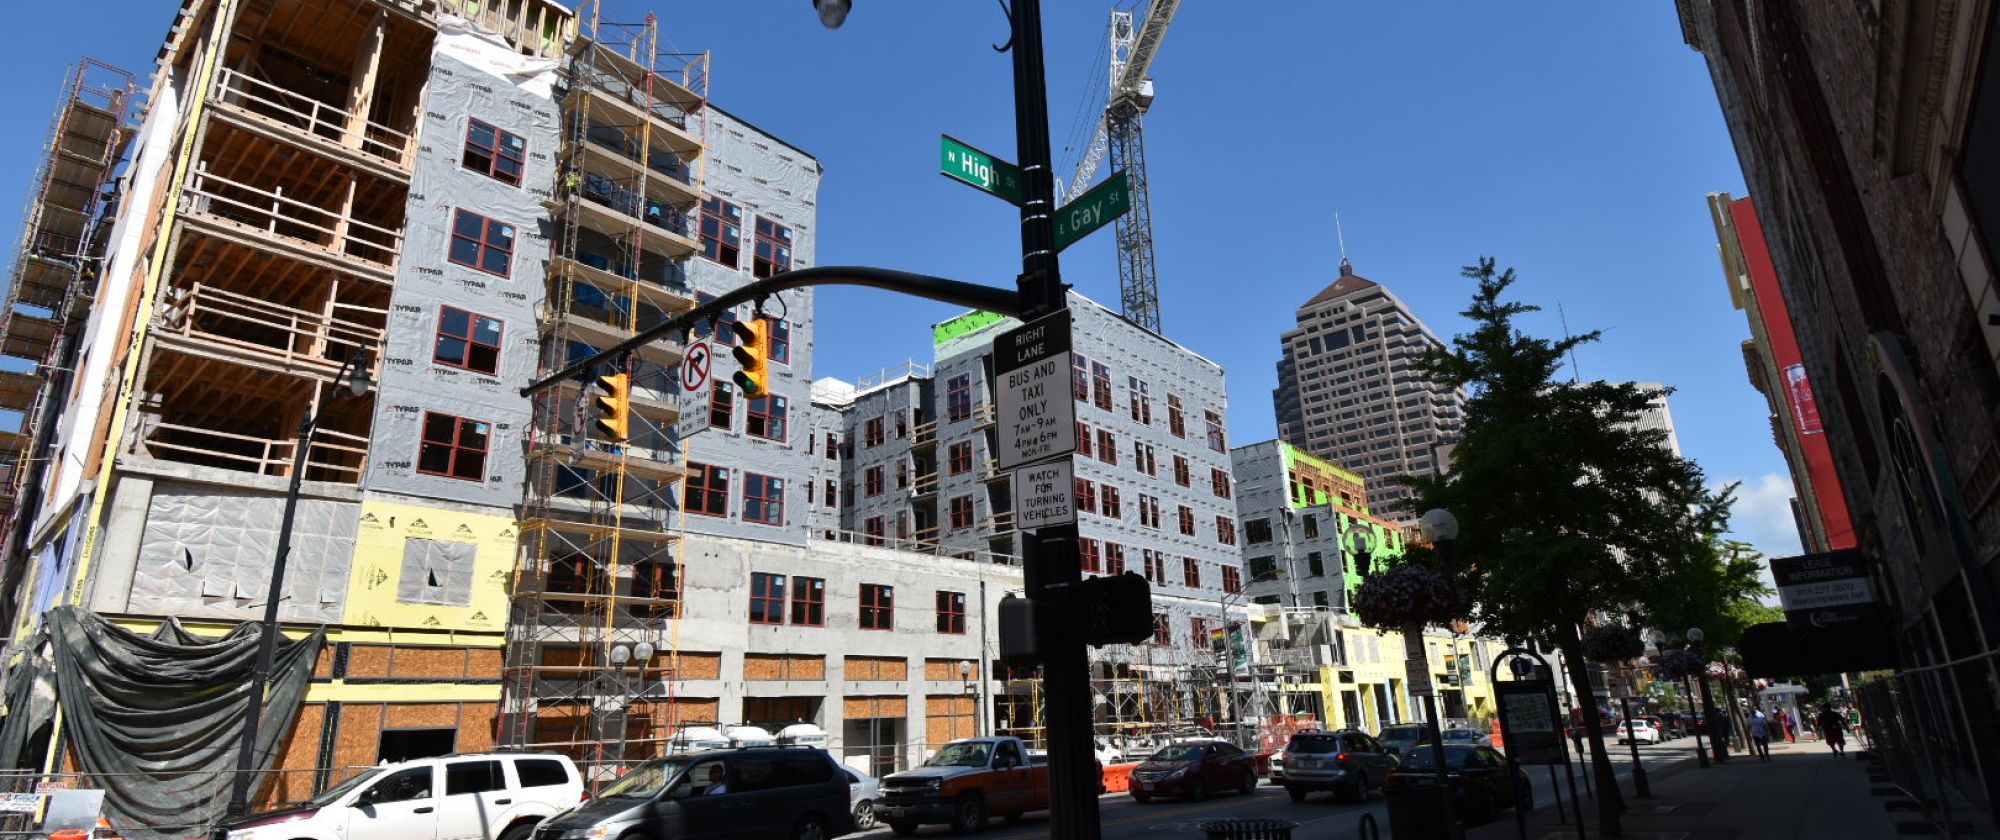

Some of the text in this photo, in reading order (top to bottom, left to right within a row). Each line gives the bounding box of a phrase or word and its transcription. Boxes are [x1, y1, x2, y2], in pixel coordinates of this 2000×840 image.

[948, 150, 955, 163] N
[962, 152, 1000, 187] High
[1059, 191, 1120, 235] E Gay St
[418, 265, 444, 278] TYPAR
[461, 278, 486, 290] TYPAR
[503, 291, 527, 301] TYPAR
[394, 304, 422, 314] TYPAR
[1015, 325, 1046, 348] RIGHT
[1017, 341, 1046, 363] LANE
[1009, 360, 1056, 389] BUS AND
[1021, 383, 1045, 402] TAXI
[1019, 399, 1048, 421] ONLY
[1028, 469, 1059, 483] WATCH
[1035, 482, 1053, 494] FOR
[1024, 492, 1065, 508] TURNING
[1023, 505, 1069, 521] VEHICLES
[1802, 556, 1832, 569] LEASE
[1788, 565, 1854, 582] INFORMATION
